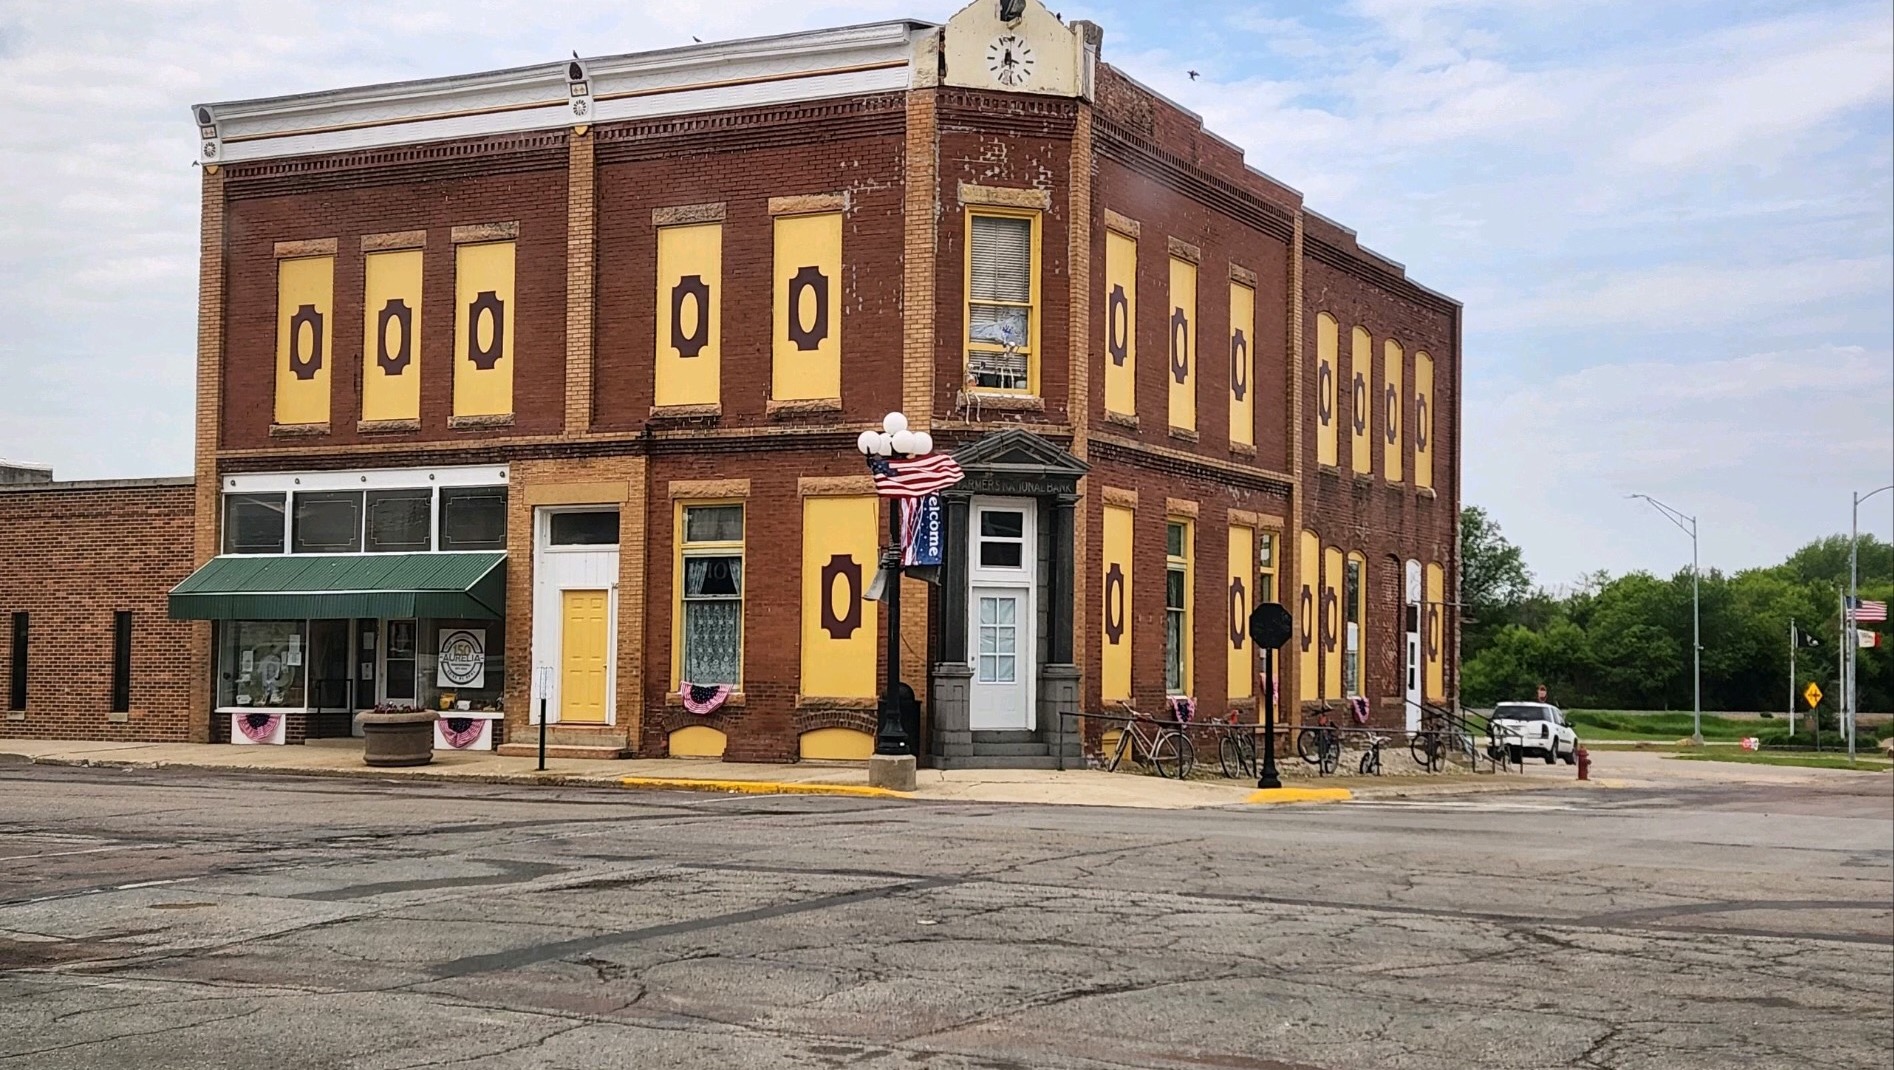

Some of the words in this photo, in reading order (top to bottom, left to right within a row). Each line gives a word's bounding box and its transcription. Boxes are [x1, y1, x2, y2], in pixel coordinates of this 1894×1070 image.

[1047, 482, 1073, 493] BANK
[453, 644, 472, 656] 150
[443, 653, 481, 662] AURELIA
